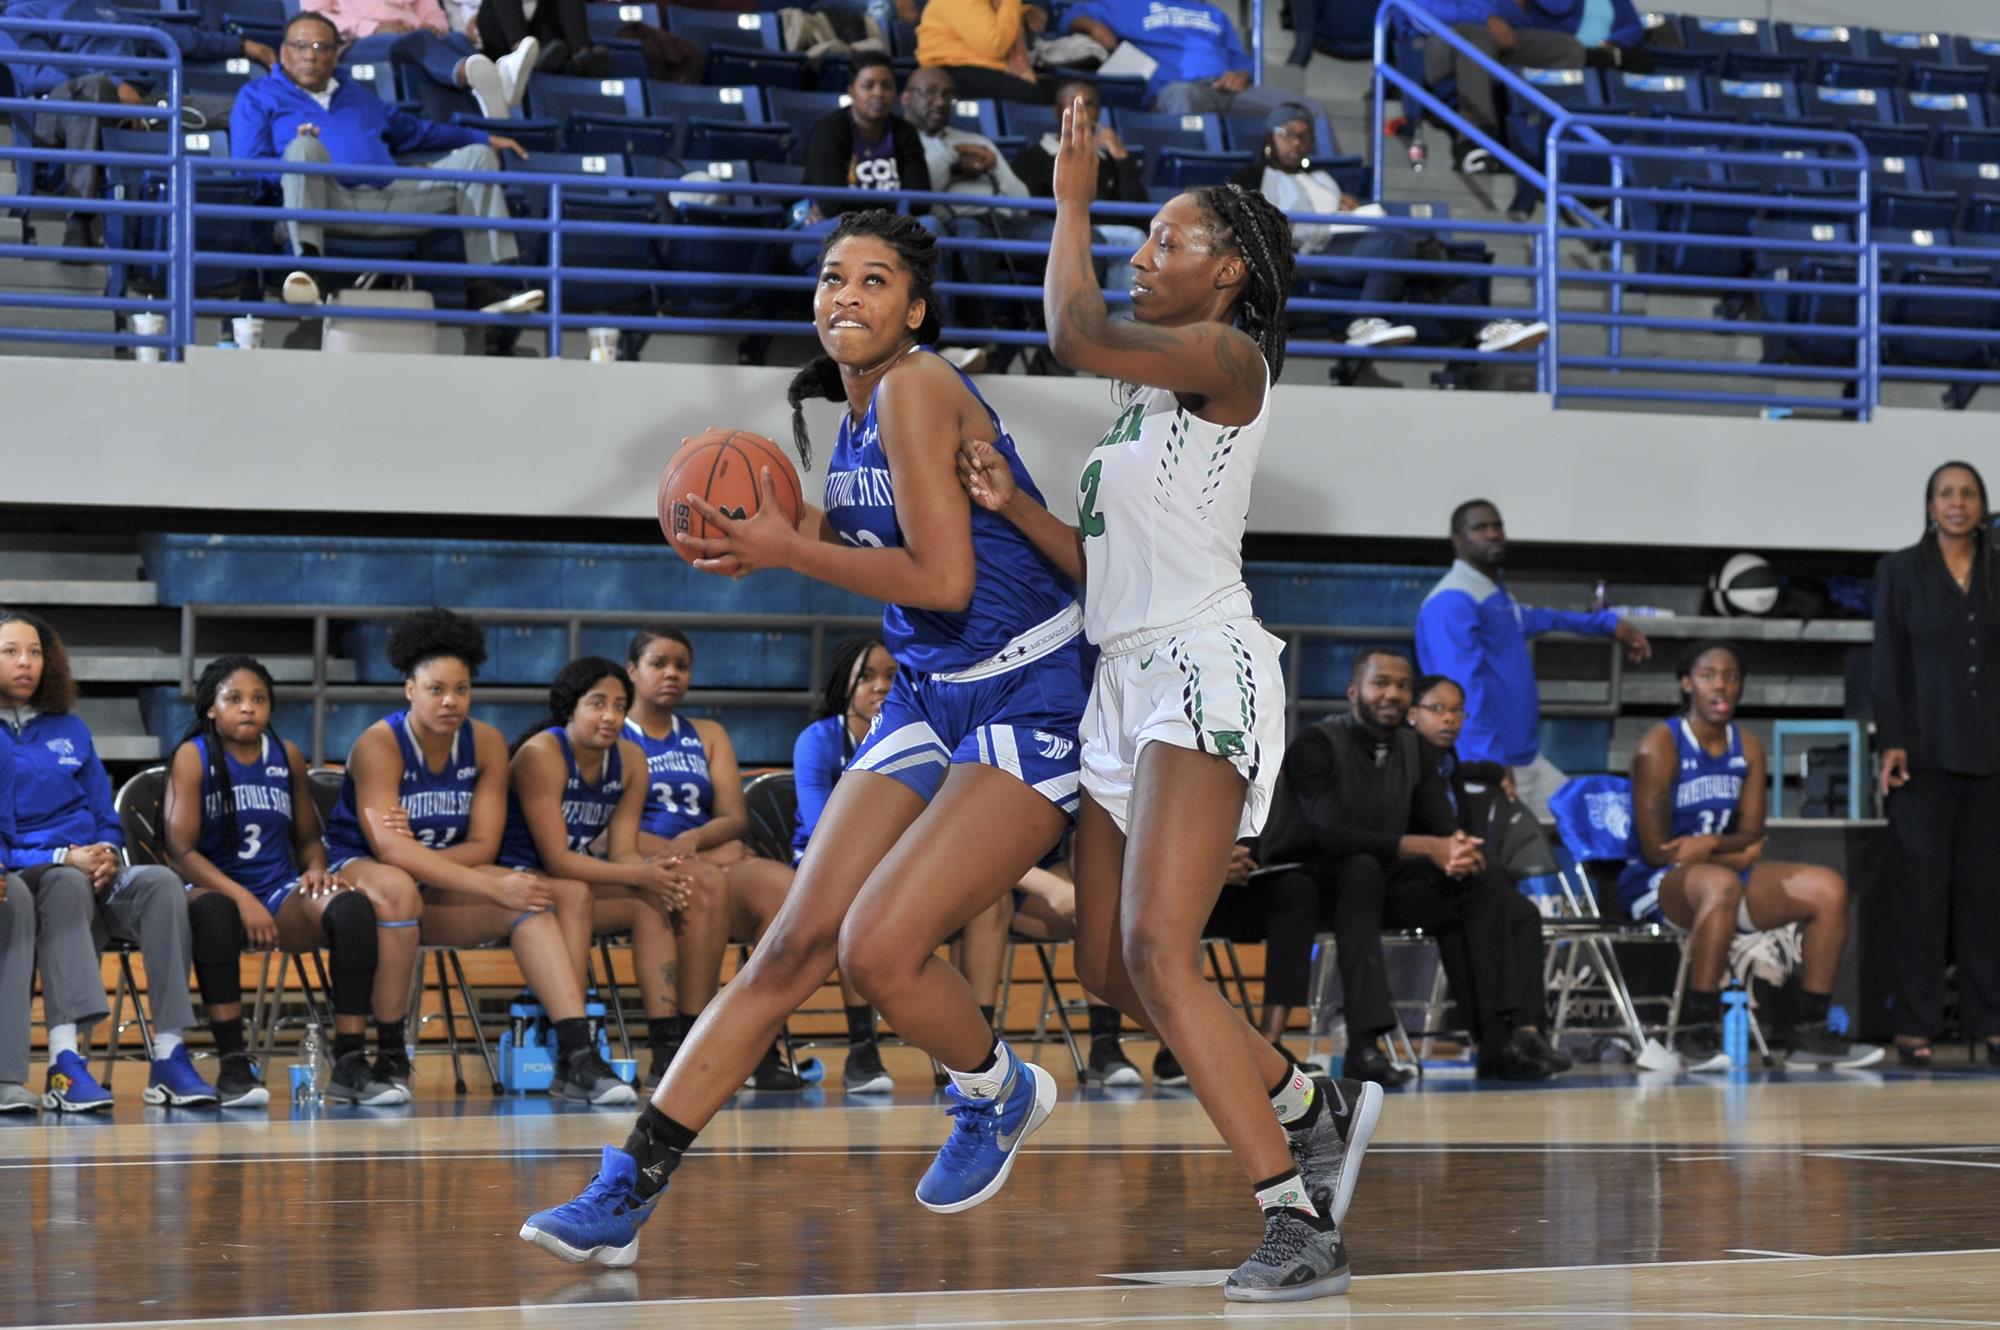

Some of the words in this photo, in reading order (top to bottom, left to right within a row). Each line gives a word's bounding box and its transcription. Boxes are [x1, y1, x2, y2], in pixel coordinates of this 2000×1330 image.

[1080, 459, 1106, 537] 2
[651, 781, 701, 816] 33
[237, 823, 262, 859] 3
[523, 1062, 554, 1073] POW
